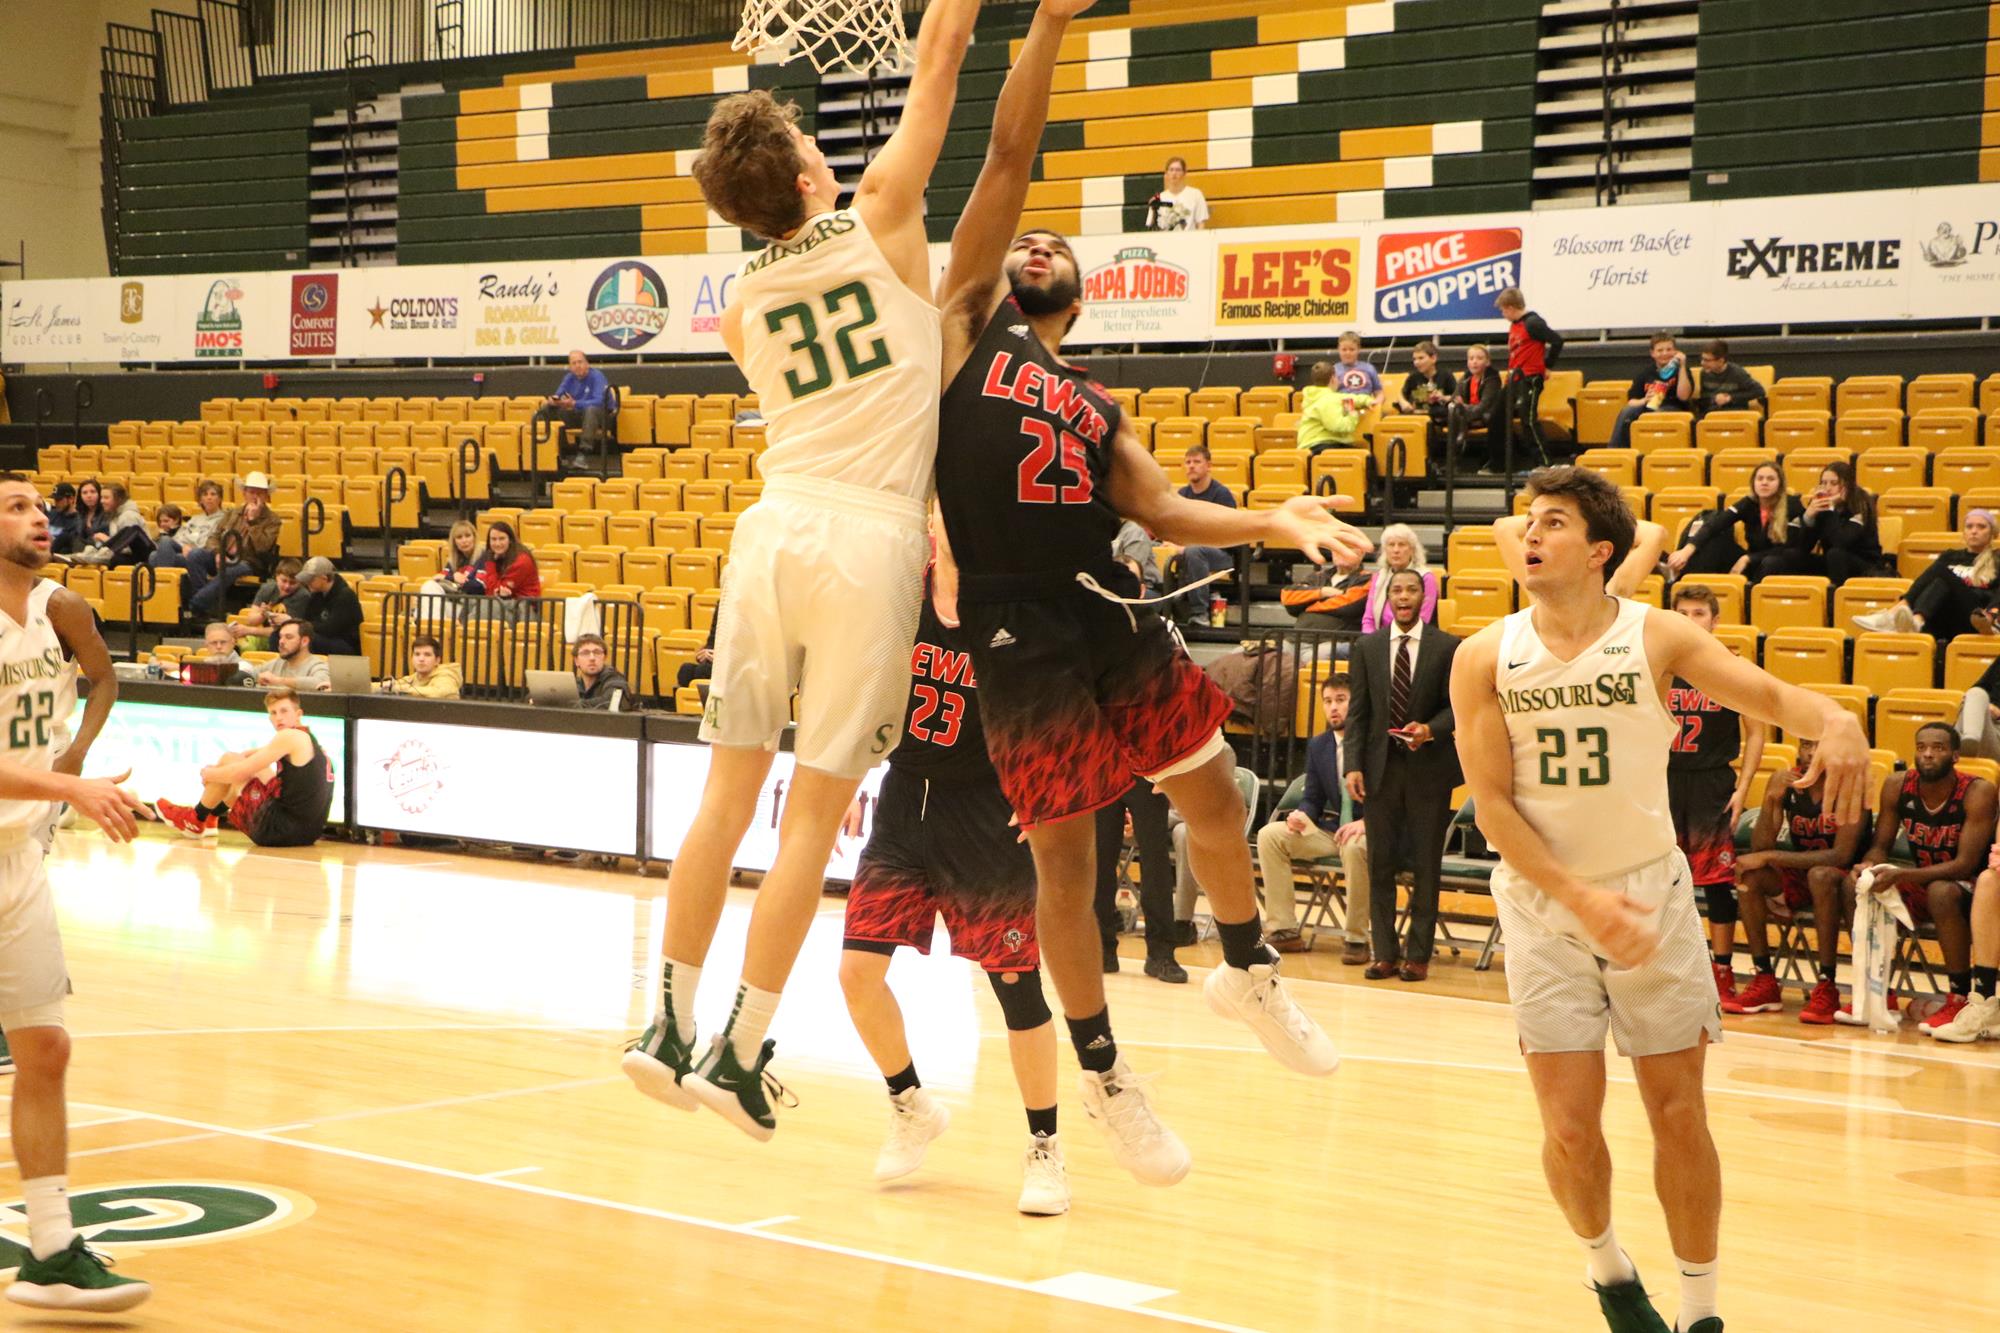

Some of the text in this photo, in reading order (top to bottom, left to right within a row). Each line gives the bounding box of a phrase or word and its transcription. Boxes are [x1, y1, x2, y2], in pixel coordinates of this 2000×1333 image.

[743, 211, 856, 277] MINERS
[1122, 248, 1149, 259] PIZZA
[1385, 232, 1468, 281] PRICE
[1553, 228, 1693, 256] Blossom Basket
[478, 272, 560, 304] Randy's
[1085, 266, 1126, 300] PAPA
[1222, 248, 1351, 300] LEE'S
[1587, 265, 1649, 290] Florist
[1771, 276, 1898, 292] Accessories
[1380, 260, 1516, 320] CHOPPER
[43, 304, 81, 334] James
[292, 313, 336, 330] COMFORT
[390, 298, 458, 318] COLTON'S
[1089, 307, 1119, 319] Better
[1221, 298, 1349, 319] Famous Recipe Chicken
[390, 319, 408, 330] Steak
[410, 318, 430, 330] House
[442, 318, 457, 329] Grill
[504, 326, 517, 346] &
[519, 325, 560, 345] GRILL
[1103, 321, 1133, 332] Better
[12, 333, 82, 346] GOLF CLUB
[195, 332, 243, 348] IMO'S
[292, 332, 334, 348] SUITES
[764, 280, 892, 399] 32
[981, 350, 1110, 449] LEWIS
[1018, 416, 1094, 504] 25
[911, 642, 978, 688] EWI
[1603, 645, 1631, 655] GLVC
[1498, 672, 1642, 715] MISSOURI S&T
[10, 691, 54, 749] 22
[909, 684, 966, 747] 23
[1671, 715, 1703, 752] 12
[1535, 726, 1611, 787] 23
[1904, 818, 1961, 848] LEWIS
